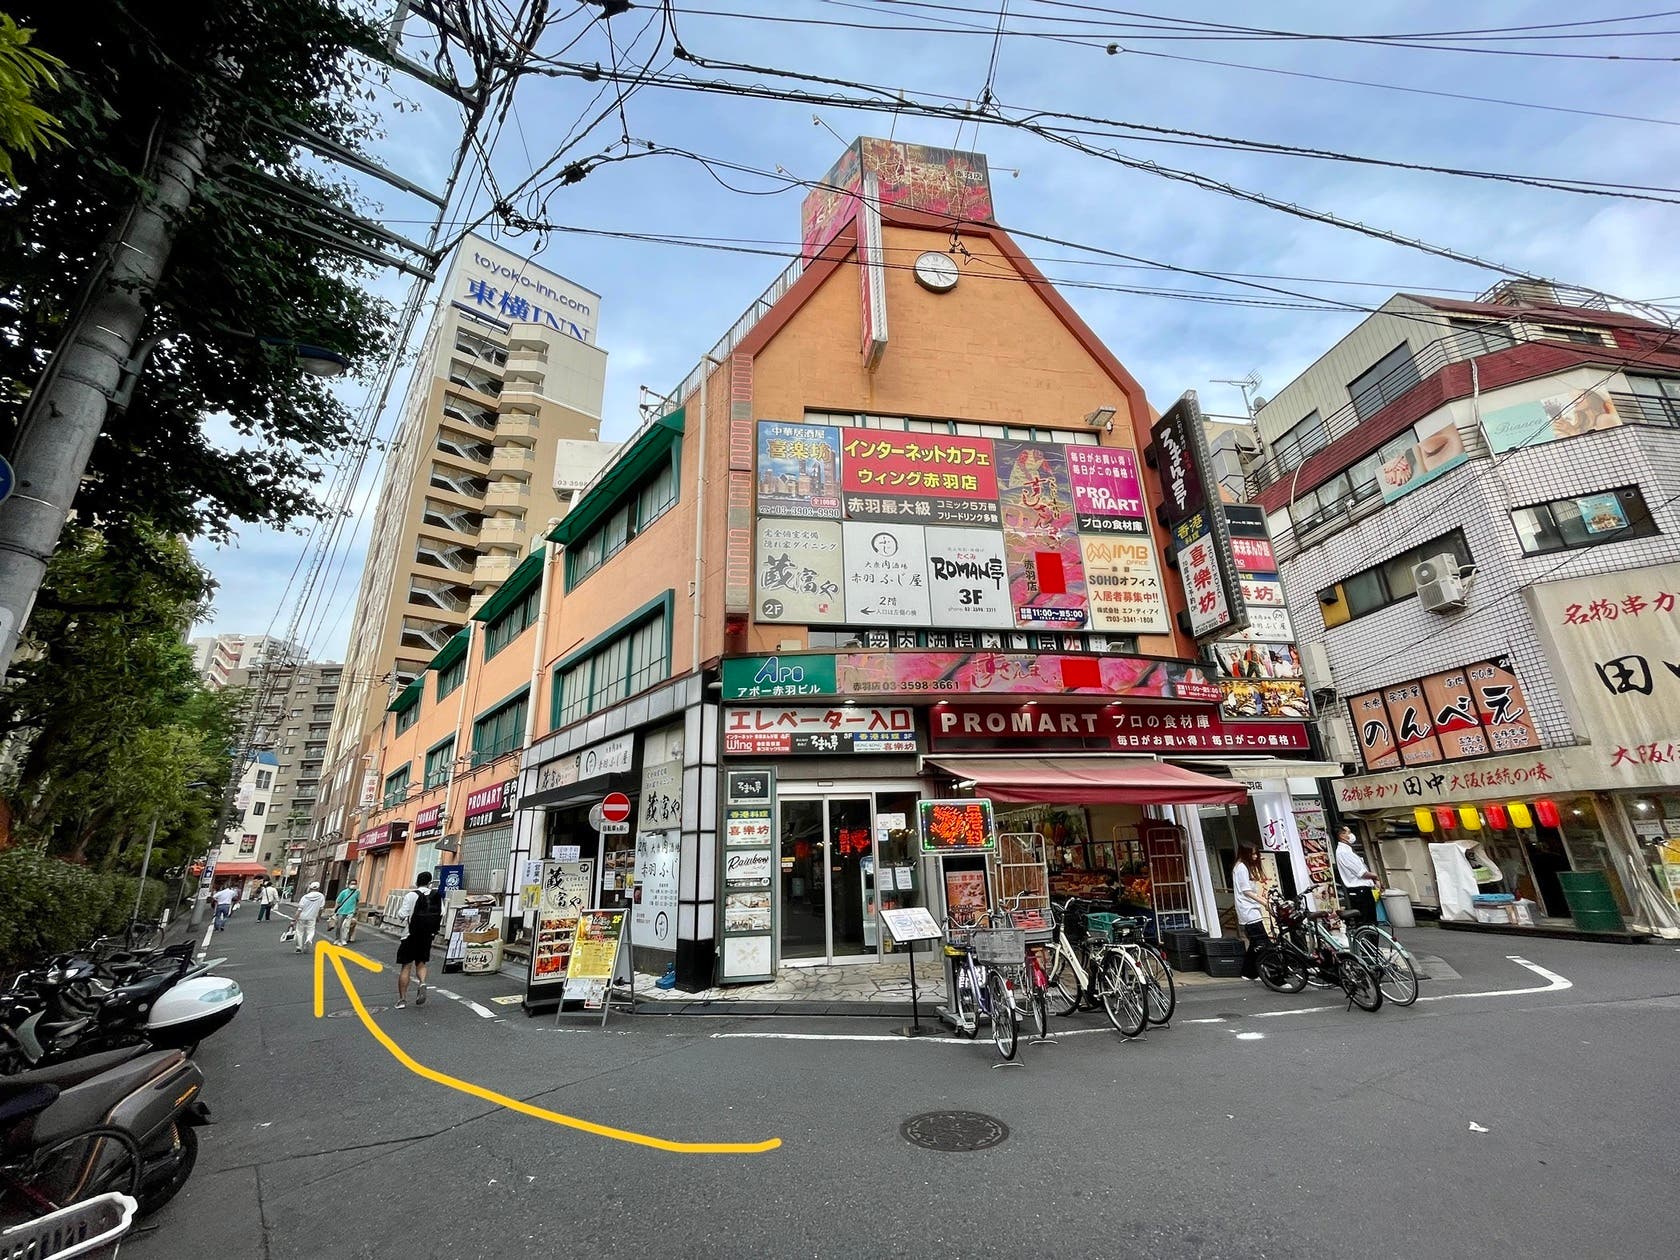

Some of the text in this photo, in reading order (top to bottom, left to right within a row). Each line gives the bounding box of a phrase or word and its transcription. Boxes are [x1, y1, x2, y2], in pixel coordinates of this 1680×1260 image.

[474, 252, 590, 316] toyoko-inn.com
[464, 278, 590, 341] 東横INN
[771, 426, 825, 439] 中華居酒屋
[767, 438, 833, 463] 喜楽坊
[844, 439, 991, 467] インターネットカフェ
[857, 469, 978, 491] ウィング赤羽店
[1076, 486, 1110, 499] PRO
[848, 498, 931, 516] 赤羽最大級
[1092, 499, 1139, 512] MART
[937, 512, 999, 523] フリードリンク多数
[1081, 518, 1143, 531] プロの食材庫
[763, 540, 838, 551] 隠れ家ダイニング
[1113, 544, 1148, 559] IMB
[1024, 560, 1038, 592] 赤羽店
[1089, 574, 1157, 587] SOHOオフィス
[879, 596, 897, 607] 2階
[959, 588, 983, 605] 3F
[764, 603, 782, 615] 2F
[1562, 590, 1680, 625] 名物串カ
[1217, 611, 1228, 623] 3F
[737, 684, 821, 697] アポー赤羽ビル
[900, 681, 929, 690] 3598
[933, 681, 960, 690] 3661
[729, 709, 911, 731] エレベーター入口
[940, 712, 1098, 733] PROMART
[1112, 714, 1210, 729] プロの食材庫
[1363, 684, 1524, 748] のんべえ
[726, 740, 753, 751] Wing
[1117, 735, 1297, 746] 毎日がお買い得！ 毎日がこの価格！
[503, 780, 518, 795] 店内
[1240, 781, 1263, 790] 羽店
[1342, 761, 1553, 802] 名物串カツ 田中 大阪伝統の味
[467, 787, 502, 811] PROMART
[728, 853, 769, 872] Rainbow
